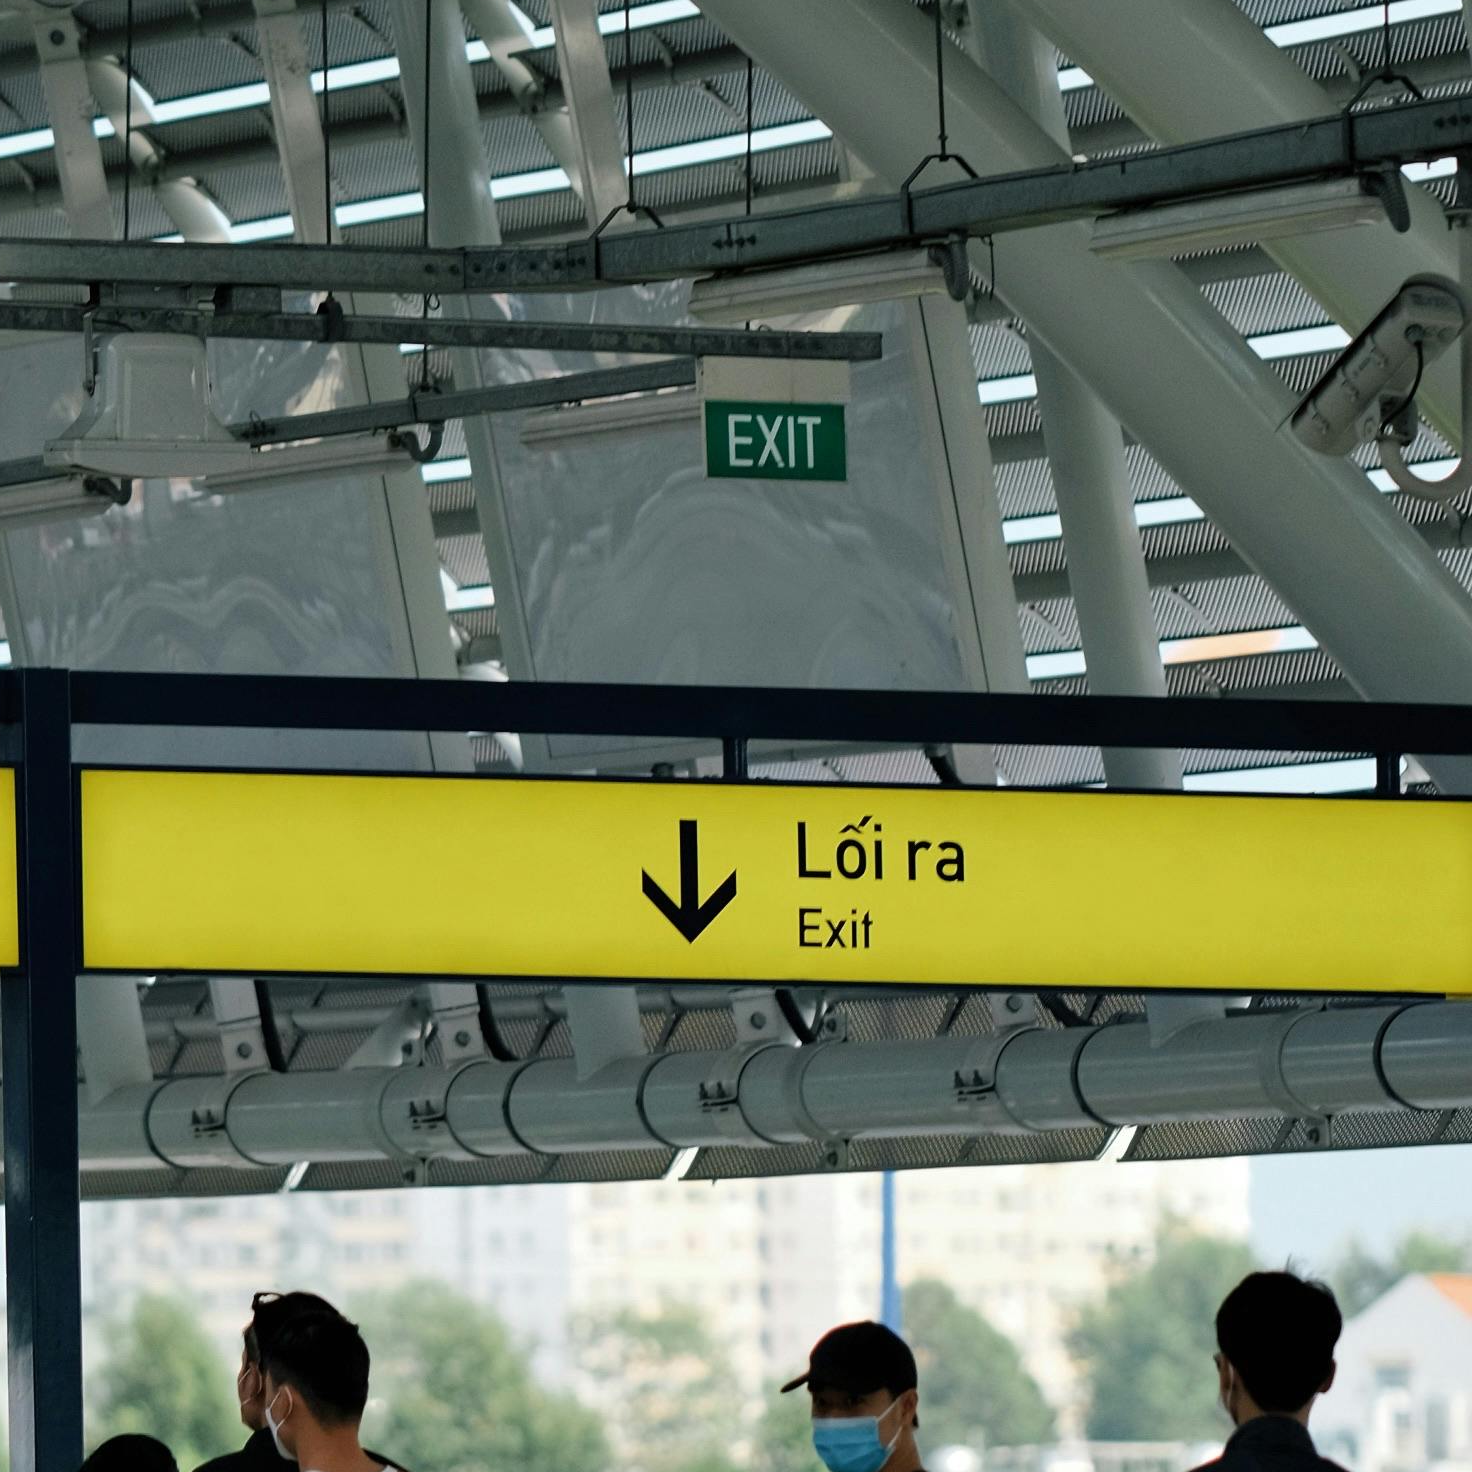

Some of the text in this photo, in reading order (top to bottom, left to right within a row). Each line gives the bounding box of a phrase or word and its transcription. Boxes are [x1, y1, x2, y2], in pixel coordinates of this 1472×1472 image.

[728, 414, 822, 469] EXIT
[797, 815, 965, 883] Lối ra
[798, 907, 873, 949] Exit
